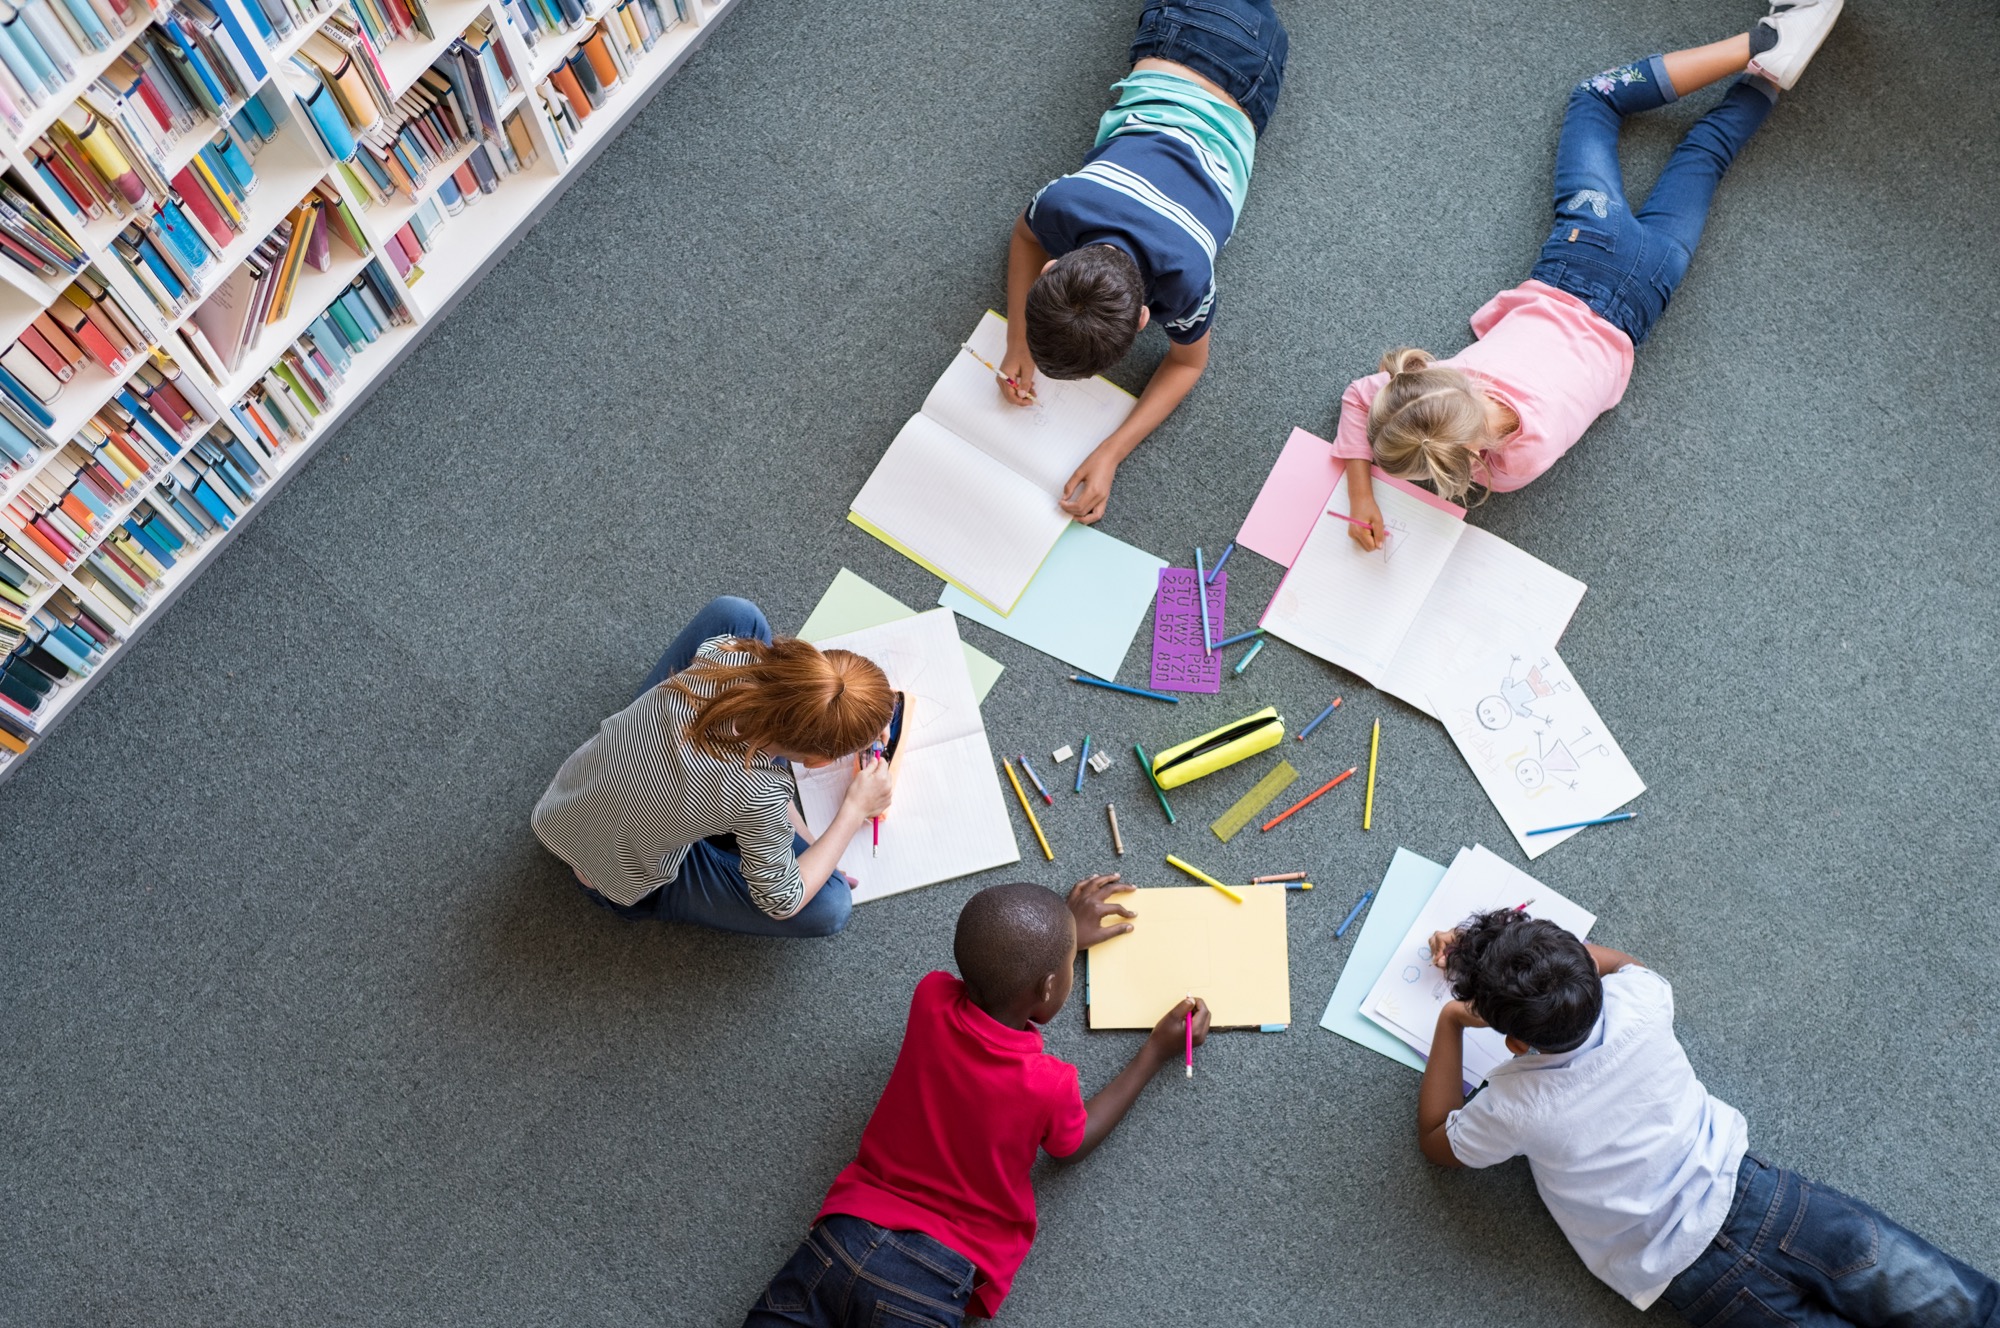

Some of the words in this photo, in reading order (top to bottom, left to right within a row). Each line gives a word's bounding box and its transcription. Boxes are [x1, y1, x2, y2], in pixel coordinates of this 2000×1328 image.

[1162, 575, 1176, 604] 234
[1176, 576, 1192, 606] STU
[1159, 614, 1174, 644] 567
[1174, 614, 1188, 646] VWX
[1189, 614, 1204, 647] MNO
[1155, 652, 1170, 682] 890
[1170, 654, 1186, 682] YZ1
[1188, 654, 1201, 684] PQR
[1202, 655, 1216, 684] GHI
